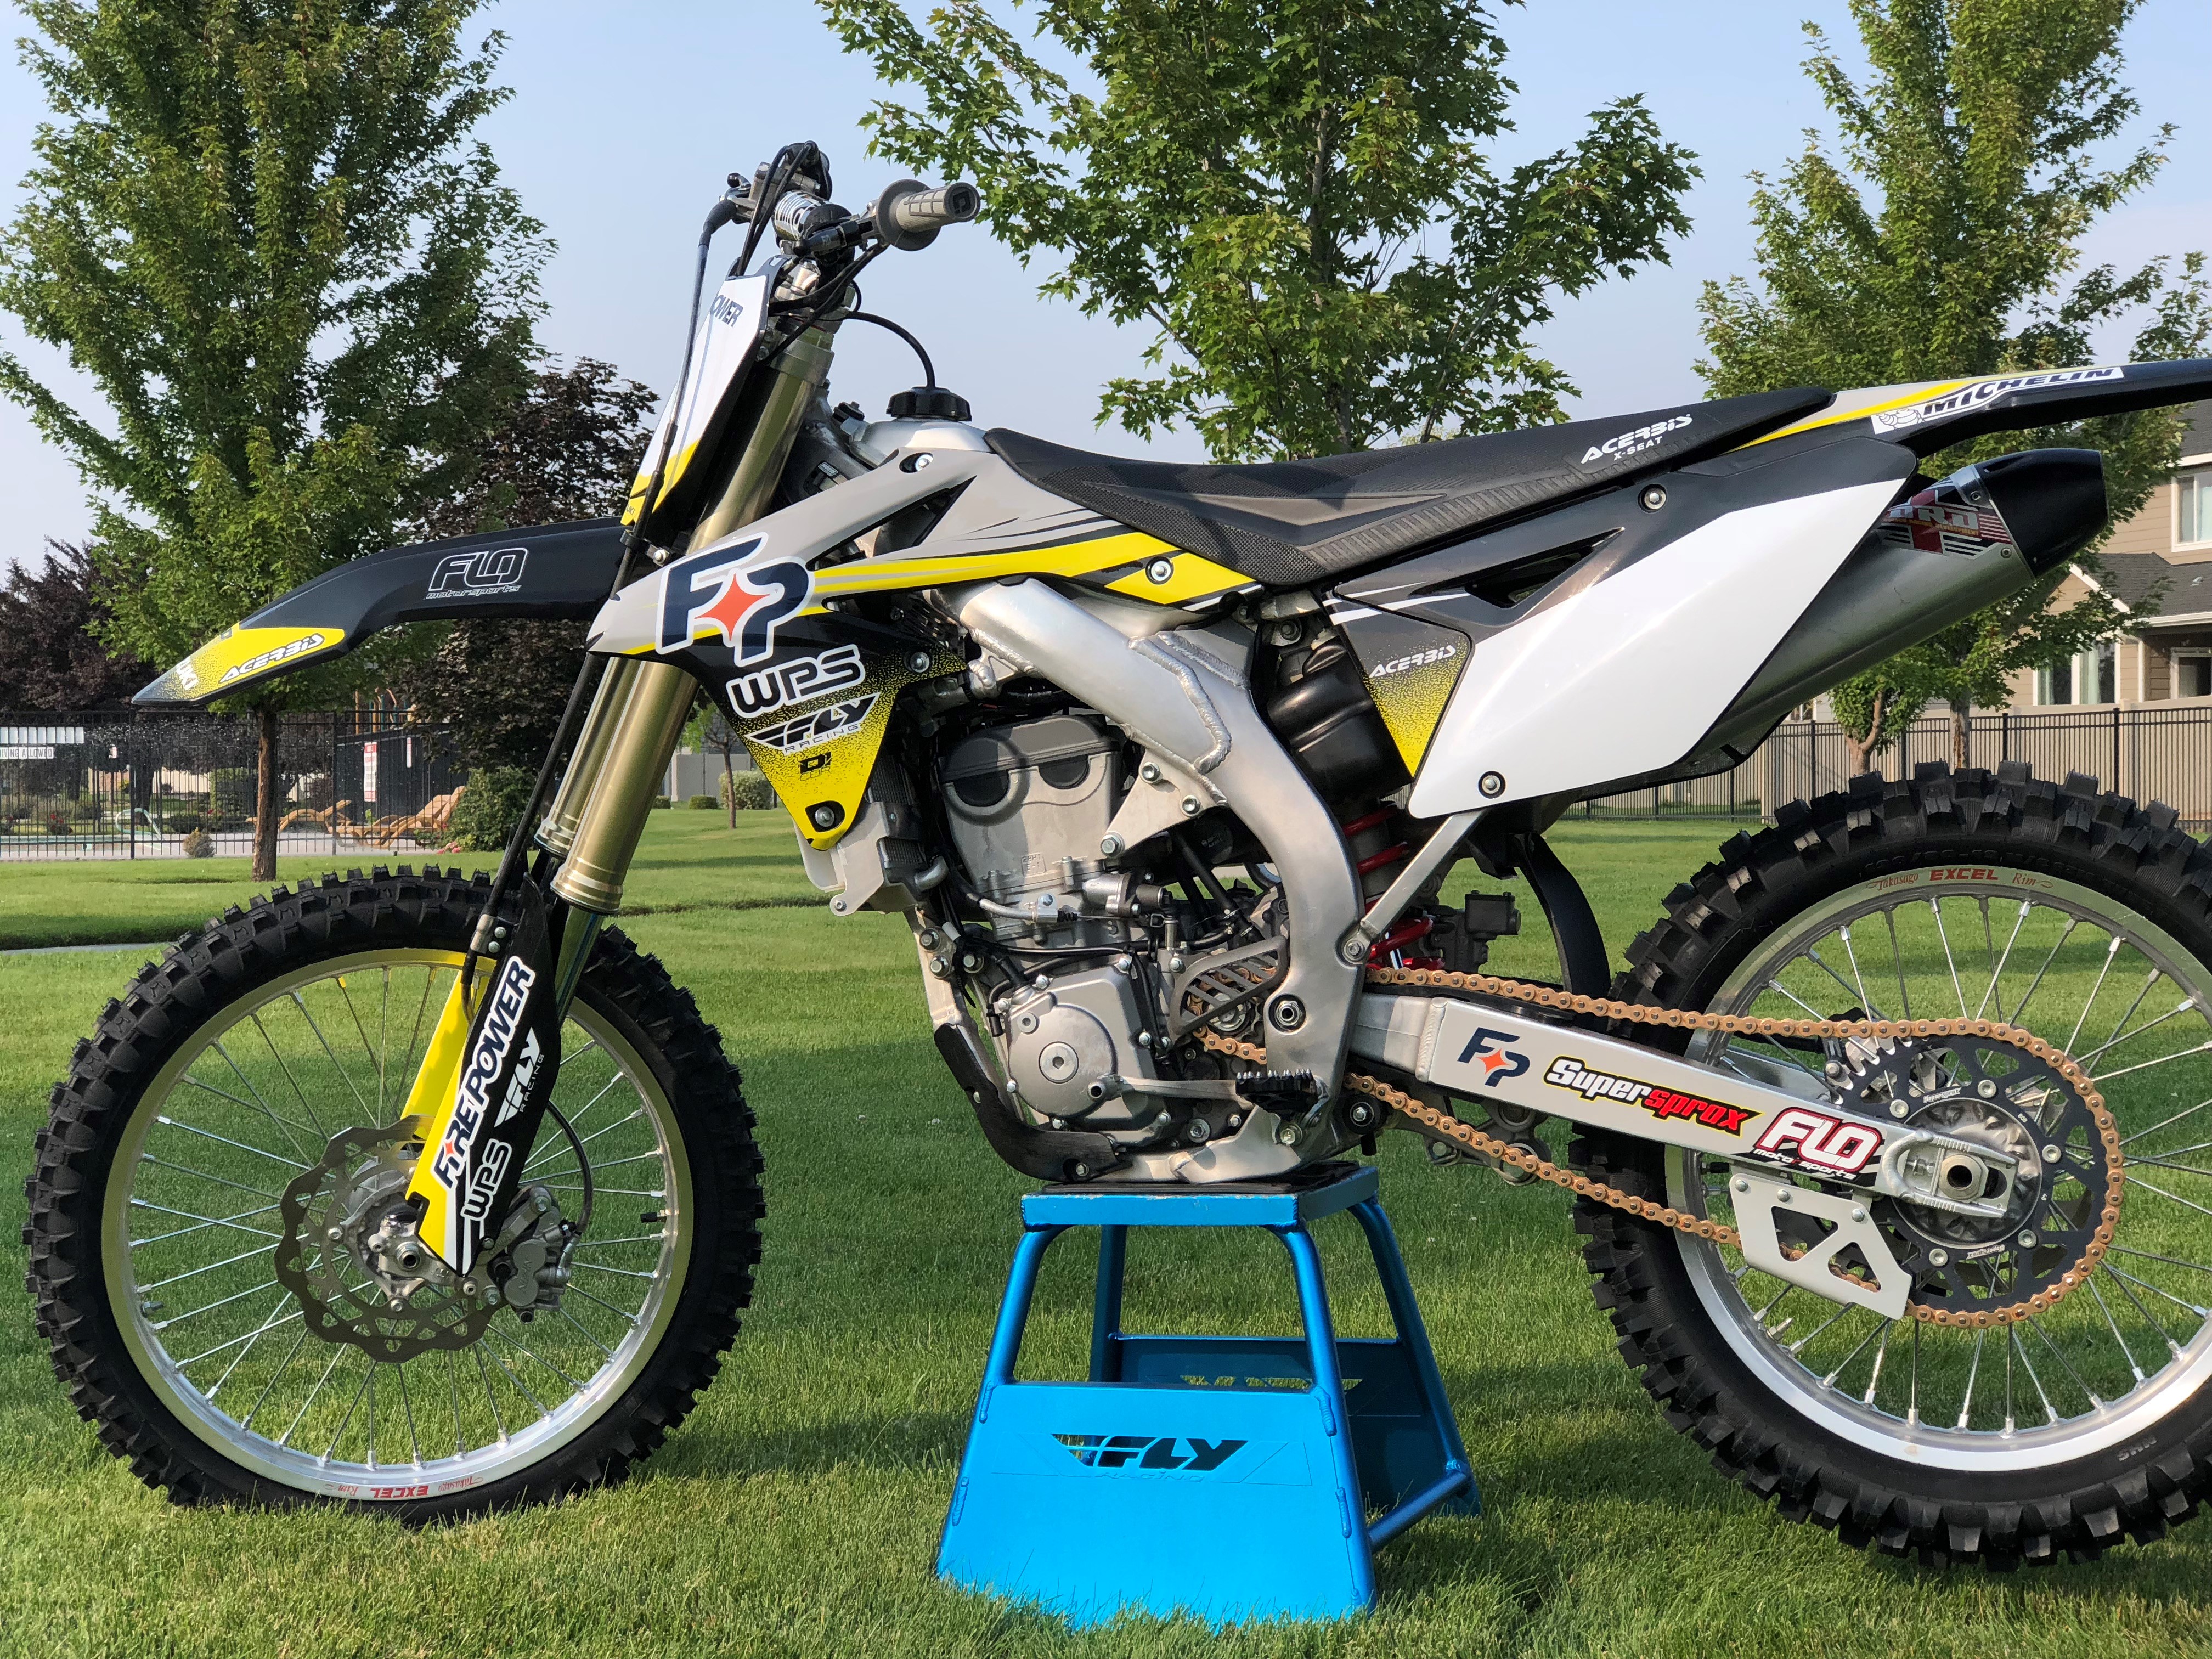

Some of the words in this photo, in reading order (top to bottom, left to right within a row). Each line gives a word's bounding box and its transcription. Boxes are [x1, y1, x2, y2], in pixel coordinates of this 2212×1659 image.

[710, 290, 743, 327] OWER
[1923, 368, 2114, 416] MICHELIN
[1613, 436, 1663, 461] X-SEAT
[428, 547, 528, 591] FLO
[425, 584, 522, 600] motorsports
[728, 646, 864, 716] WPS
[747, 693, 879, 747] FLY
[785, 724, 859, 753] RACING
[22, 748, 52, 758] ALOWED
[1929, 868, 1999, 881] EXCEL
[2011, 872, 2045, 887] Rim
[494, 1027, 541, 1128] FLY
[518, 1053, 545, 1113] RACING
[1547, 1058, 1752, 1132] Supersprox
[1756, 1108, 1883, 1171] FLO
[461, 1139, 511, 1221] WPS
[1753, 1147, 1858, 1181] motorsports
[1050, 1433, 1249, 1471] FLY
[331, 1484, 359, 1496] Rim
[370, 1485, 429, 1498] EXCEL
